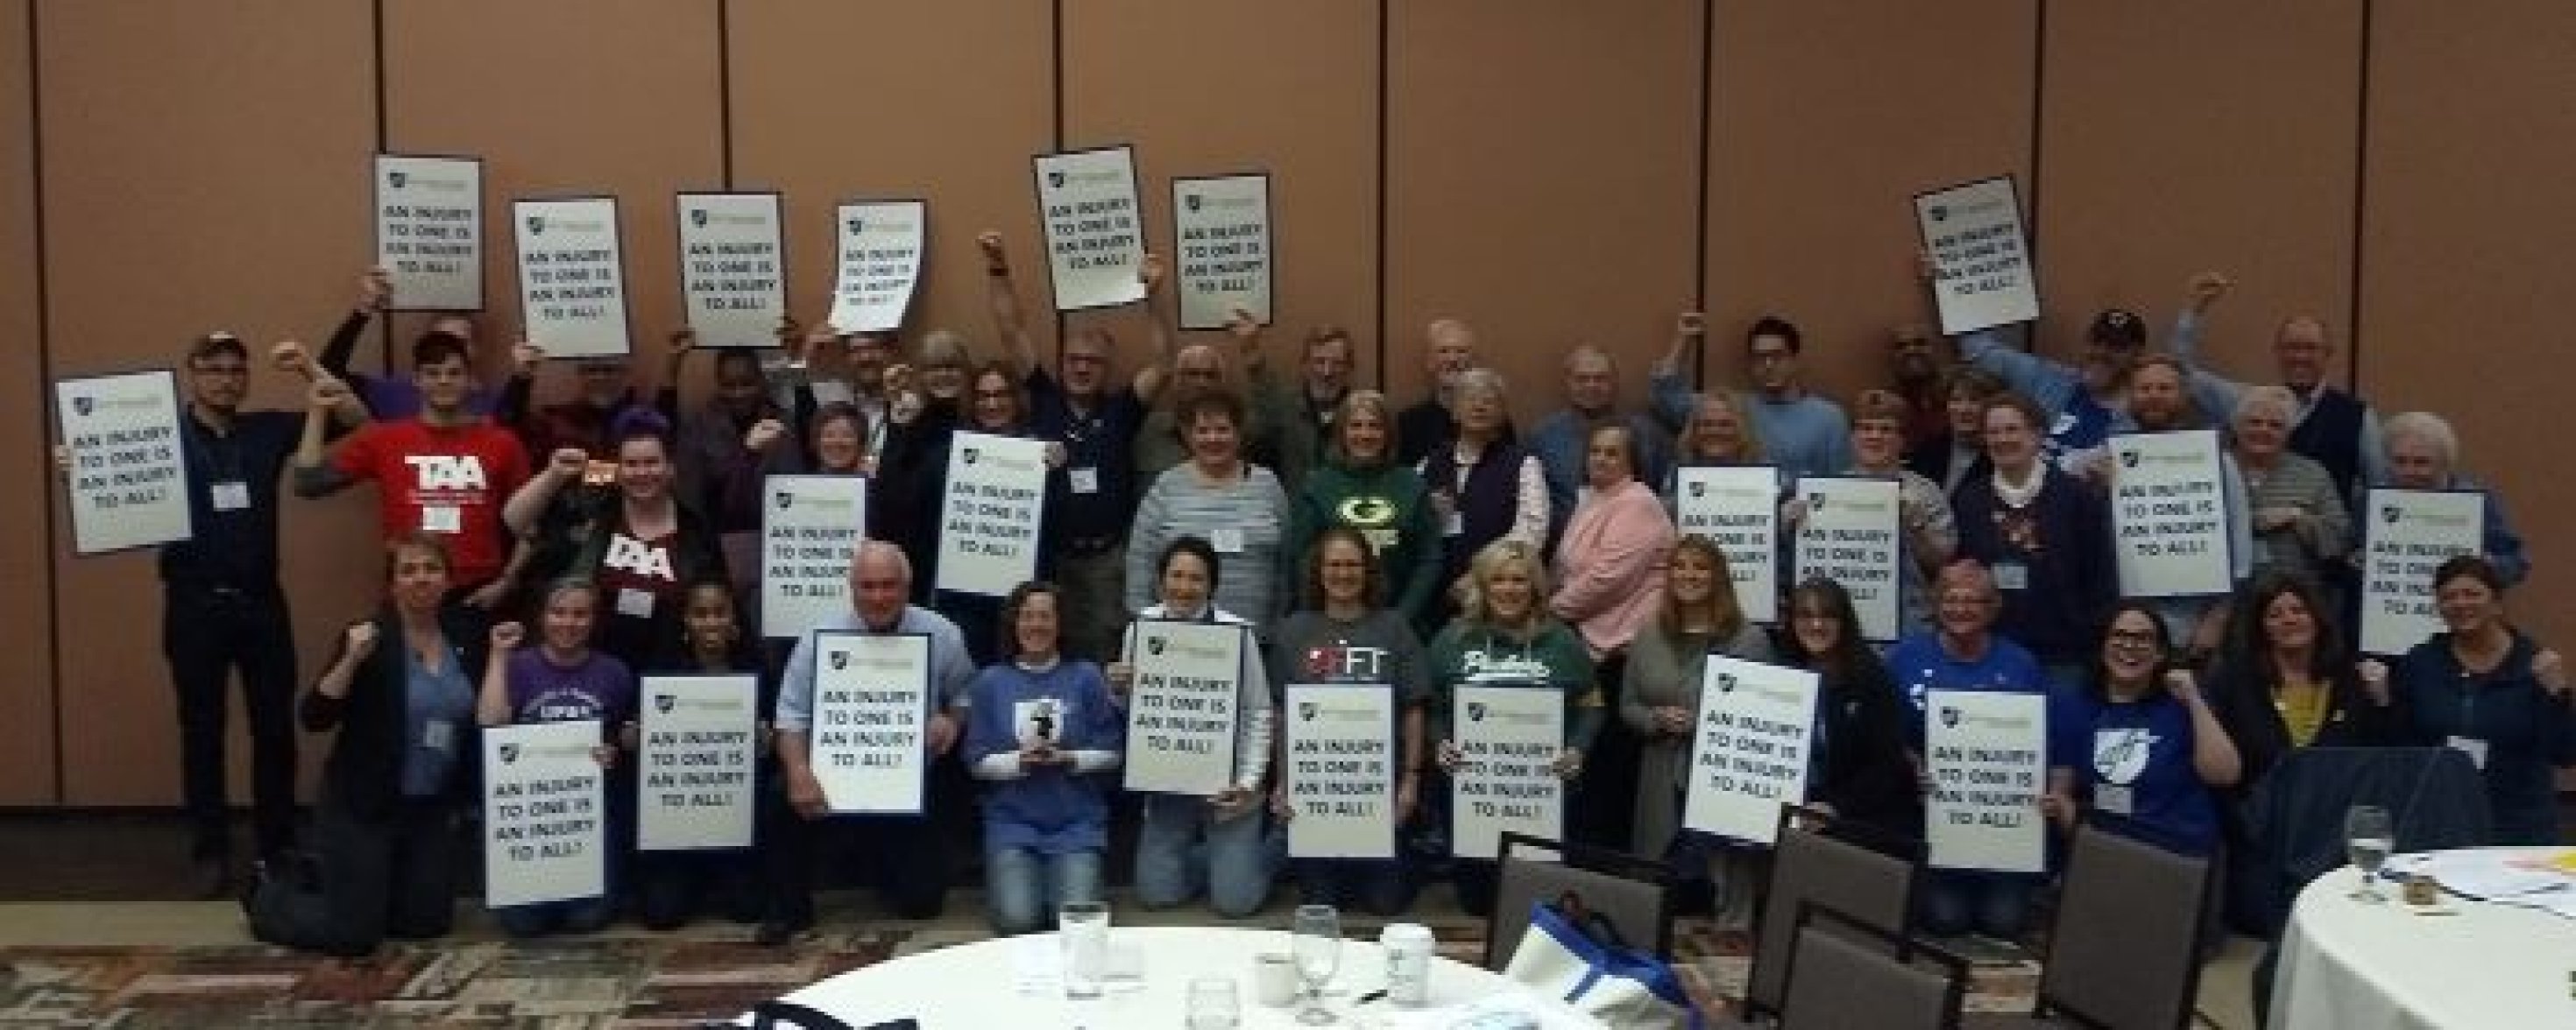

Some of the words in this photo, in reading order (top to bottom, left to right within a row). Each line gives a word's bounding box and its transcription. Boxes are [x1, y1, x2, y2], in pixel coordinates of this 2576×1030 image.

[693, 261, 715, 273] TO
[717, 261, 750, 273] ONE
[706, 298, 725, 309] TO
[81, 455, 103, 468] TO
[111, 449, 149, 464] ONE
[404, 455, 486, 490] TAA
[92, 493, 118, 508] TO
[954, 500, 975, 514] TO
[978, 504, 1008, 519] ONE
[2124, 504, 2149, 519] TO
[2153, 500, 2193, 515] ONE
[775, 545, 795, 559] TO
[798, 547, 832, 559] ONE
[960, 537, 979, 552] TO
[2134, 541, 2161, 555] TO
[1807, 547, 1826, 560] TO
[1831, 549, 1865, 561] ONE
[781, 584, 803, 596] TO
[1142, 695, 1164, 709] TO
[1168, 696, 1205, 710] ONE
[824, 709, 850, 725] TO
[853, 709, 891, 725] ONE
[1148, 736, 1171, 751] TO
[1708, 732, 1735, 747] TO
[1736, 737, 1775, 754] ONE
[651, 754, 677, 765] TO
[681, 751, 721, 765] ONE
[832, 753, 857, 767] TO
[1299, 761, 1321, 772] TO
[1325, 761, 1362, 776] ONE
[1492, 761, 1528, 776] ONE
[1713, 774, 1734, 791] TO
[1939, 768, 1965, 785] TO
[1969, 769, 2009, 784] ONE
[662, 794, 684, 808] TO
[1306, 801, 1328, 816] TO
[499, 803, 523, 820] TO
[529, 801, 570, 816] ONE
[1472, 801, 1497, 817] TO
[1952, 811, 1973, 824] TO
[508, 846, 534, 861] TO
